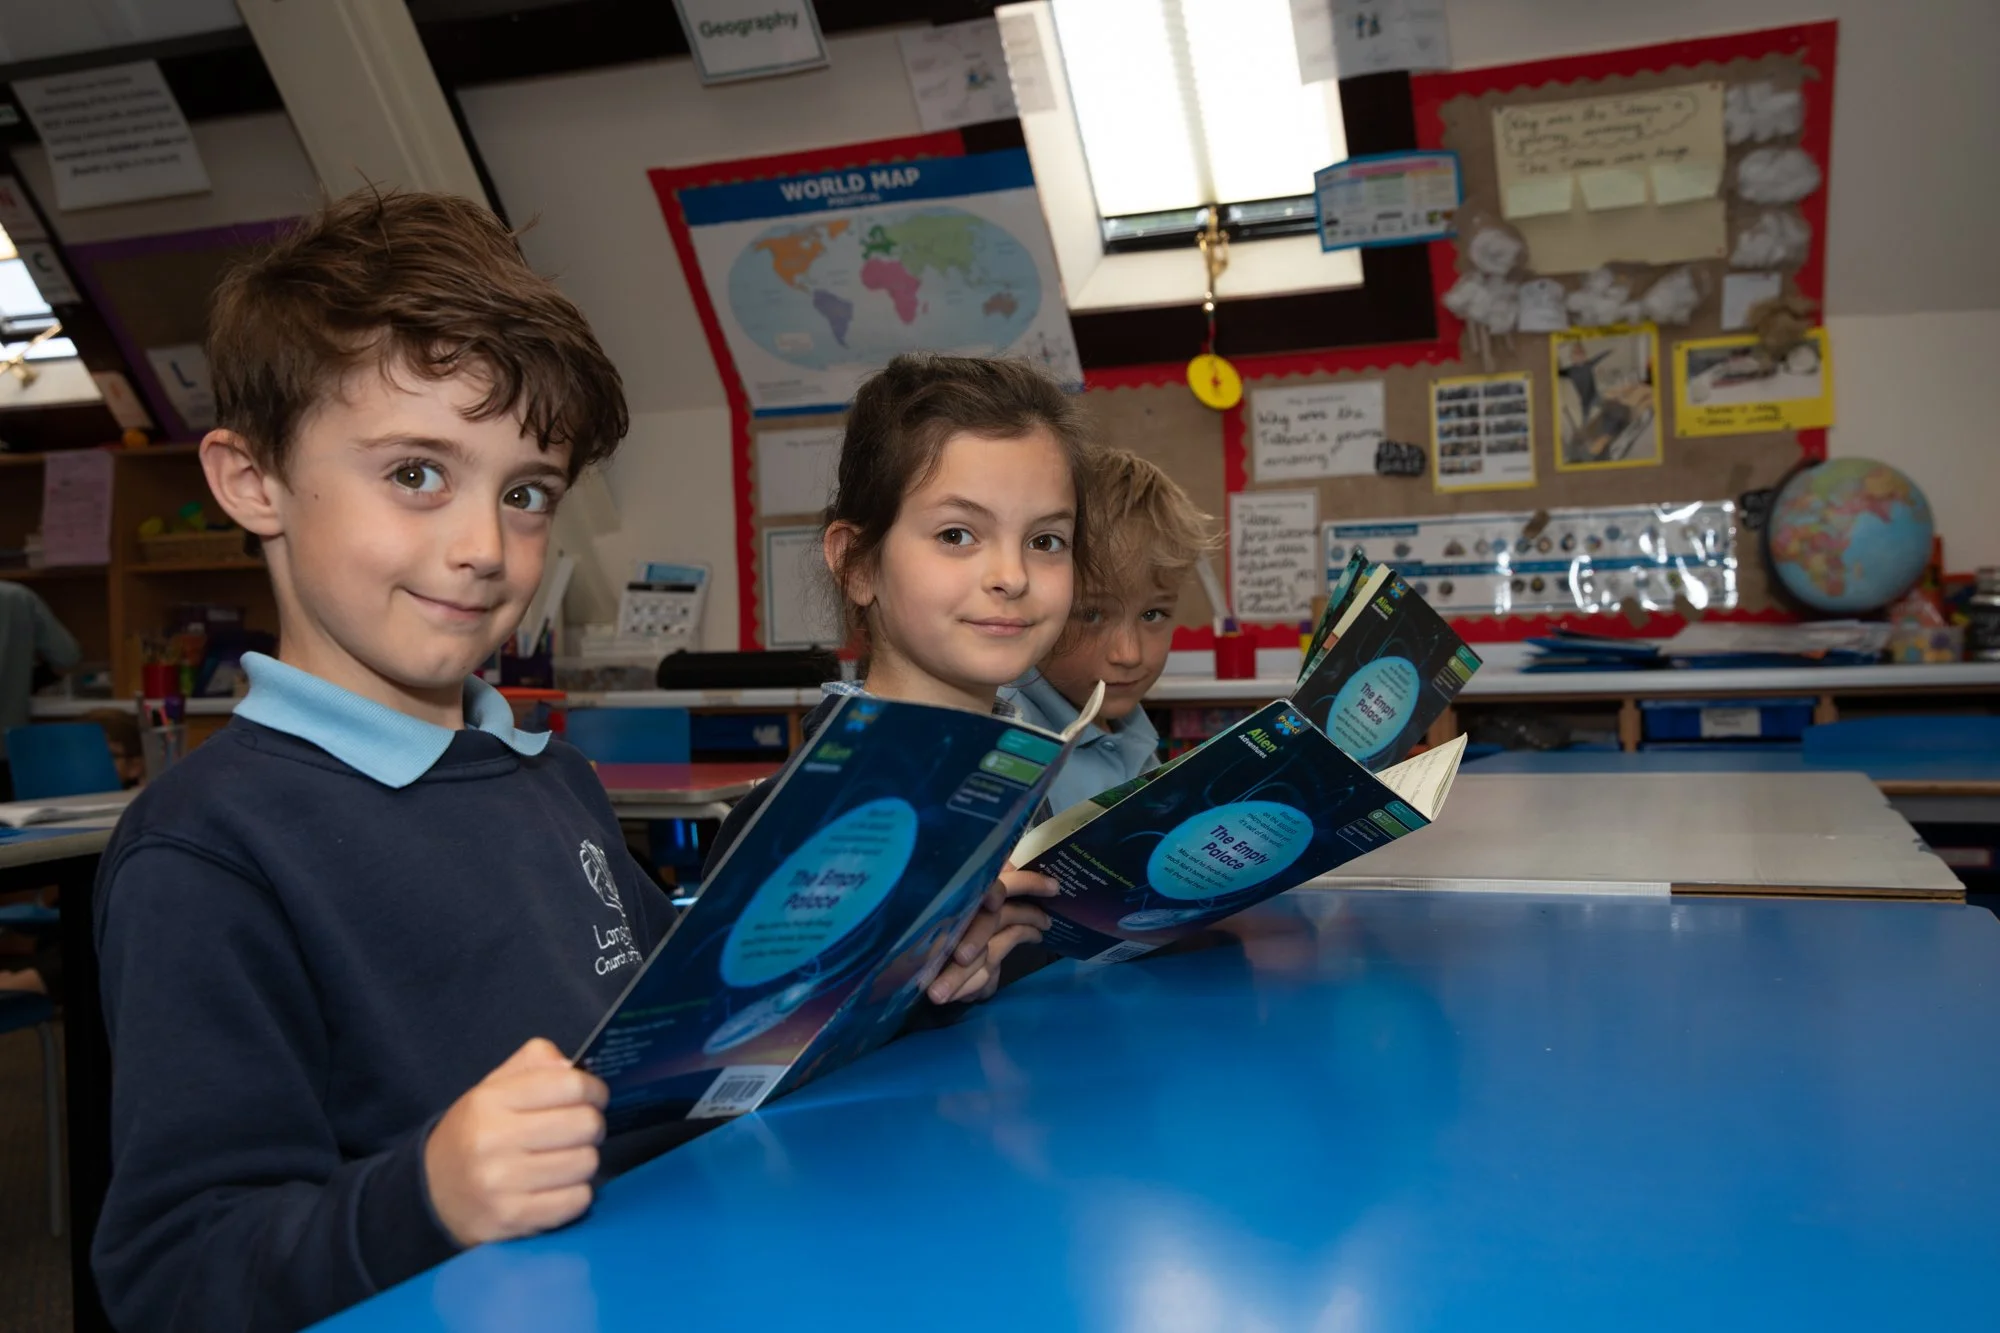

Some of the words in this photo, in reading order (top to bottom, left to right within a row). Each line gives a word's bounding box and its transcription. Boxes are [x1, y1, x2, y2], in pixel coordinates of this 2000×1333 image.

[699, 9, 799, 39] Geography
[780, 172, 867, 203] WORLD
[871, 165, 921, 192] MAP
[1256, 410, 1290, 432] Why
[1375, 596, 1394, 616] Alien
[1355, 698, 1382, 725] Palace
[1360, 682, 1375, 700] The
[1373, 694, 1397, 720] Empty
[1278, 715, 1300, 735] Project
[1238, 734, 1268, 760] Adventures
[1246, 728, 1278, 753] Alien
[1201, 842, 1245, 870] Palace
[1210, 824, 1235, 845] The
[1232, 840, 1270, 866] Empty
[1188, 854, 1200, 865] and
[817, 868, 871, 892] Empty
